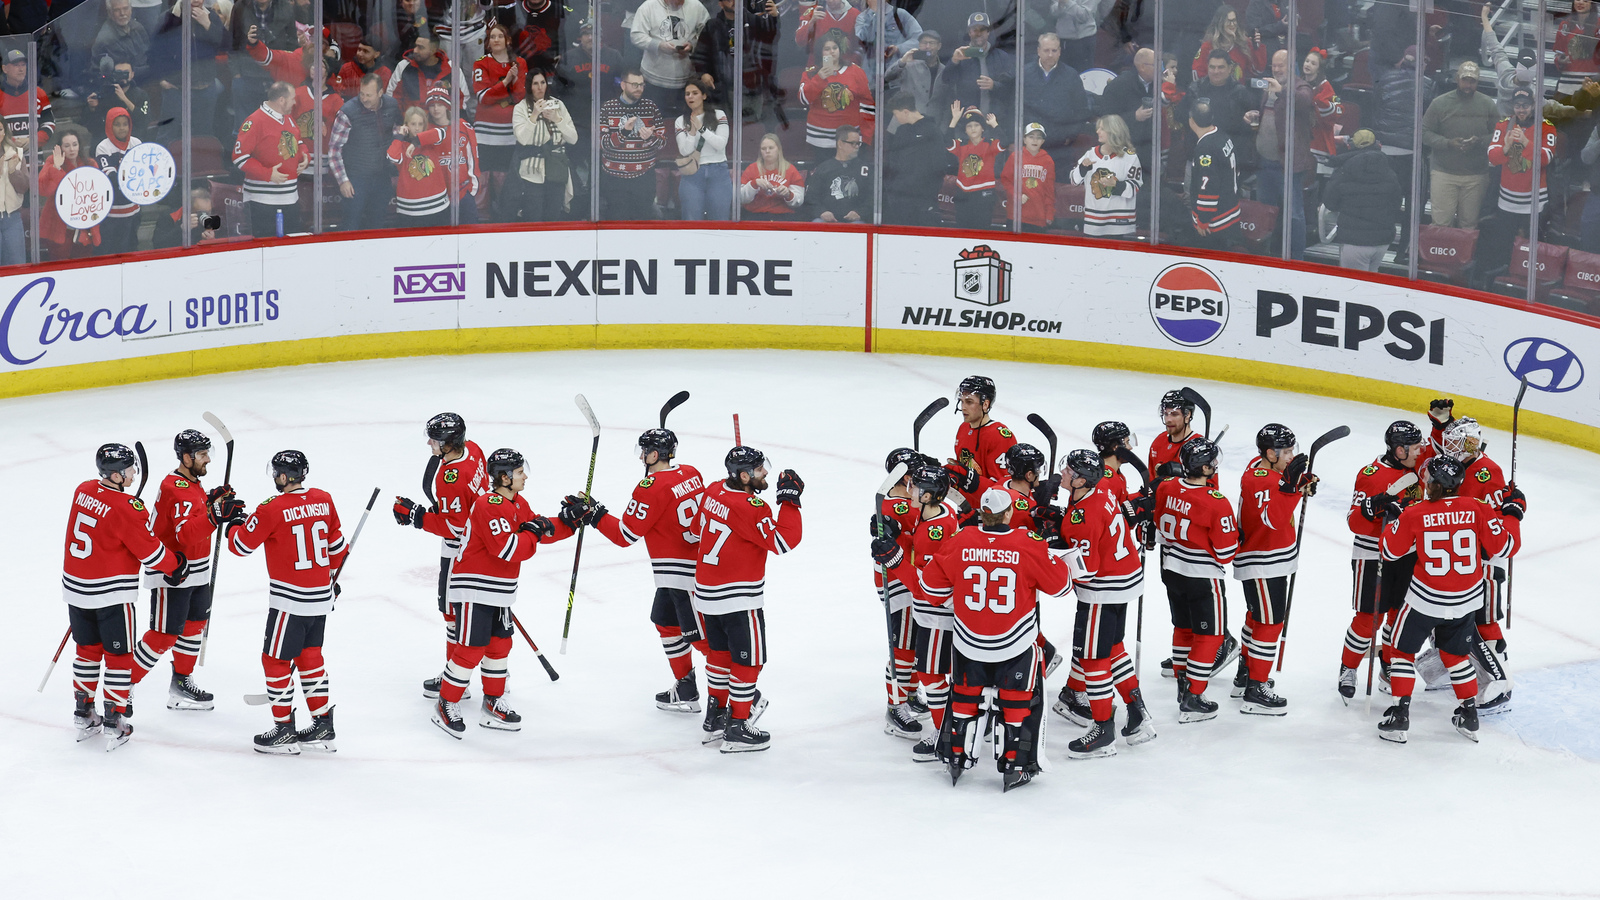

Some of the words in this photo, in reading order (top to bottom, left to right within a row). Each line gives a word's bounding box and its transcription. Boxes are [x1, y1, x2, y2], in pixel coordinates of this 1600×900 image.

[473, 68, 483, 82] 2
[1547, 134, 1556, 146] 9
[128, 166, 144, 179] go
[860, 166, 868, 176] C
[68, 172, 94, 200] You
[126, 175, 164, 192] CAPS
[1200, 176, 1209, 190] 7
[70, 196, 104, 216] Loved
[75, 192, 98, 206] are
[938, 194, 954, 204] CIBC
[1430, 246, 1448, 256] CIBC
[1522, 260, 1539, 270] CC
[394, 270, 466, 295] NEXEN
[486, 259, 658, 298] NEXEN
[674, 259, 793, 296] TIRE
[1577, 272, 1594, 282] CIBC
[186, 290, 279, 330] SPORTS
[1155, 292, 1223, 316] PEPSI
[0, 276, 156, 365] Circa
[902, 306, 1062, 334] NHLSHOP.COM
[1256, 290, 1446, 366] PEPSI
[994, 452, 1007, 470] 4
[75, 492, 112, 518] MURPHY
[441, 496, 462, 513] 14
[1166, 496, 1192, 516] NAZAR
[1254, 489, 1270, 509] 71
[1484, 489, 1504, 510] 40
[174, 500, 193, 519] 17
[282, 502, 330, 522] DICKINSON
[626, 499, 650, 520] 95
[1422, 510, 1476, 528] BERTUZZI
[488, 516, 512, 536] 98
[756, 516, 776, 540] 77
[1220, 515, 1236, 534] 91
[1391, 518, 1400, 534] 9
[69, 511, 98, 560] 5
[292, 520, 330, 570] 16
[1109, 513, 1130, 562] 7
[962, 548, 1020, 565] COMMESSO
[1424, 528, 1477, 576] 59
[964, 566, 1017, 614] 33
[1478, 642, 1502, 680] VAUGHN
